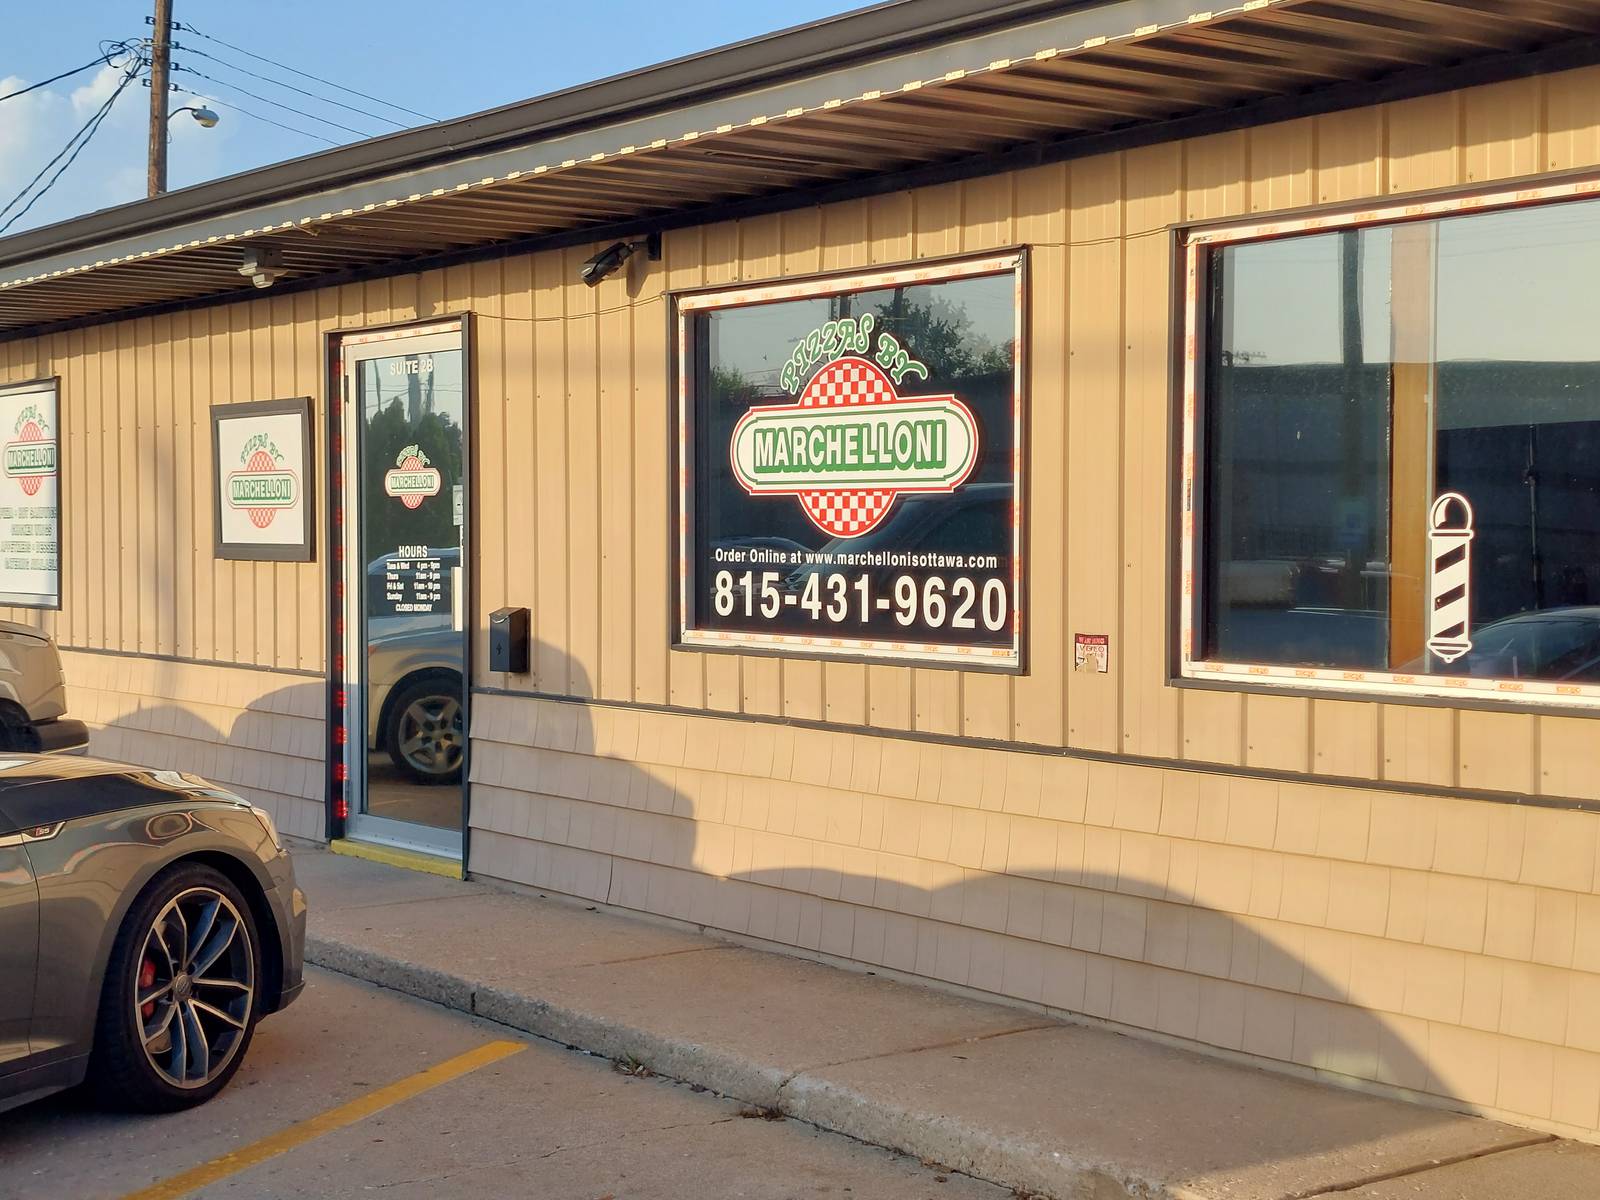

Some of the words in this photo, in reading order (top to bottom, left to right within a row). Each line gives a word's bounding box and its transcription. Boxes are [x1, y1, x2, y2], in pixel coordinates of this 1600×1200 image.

[780, 312, 875, 395] PIZZAS
[876, 332, 929, 386] BY
[390, 360, 418, 375] SUITE
[753, 419, 948, 474] MARCHELLONI
[8, 447, 54, 470] MARCHELLONI
[232, 478, 291, 500] MARCHELLONI
[398, 545, 428, 558] HOURS
[715, 548, 747, 564] Order
[749, 548, 787, 566] Online
[790, 551, 802, 566] at
[805, 549, 998, 570] www.marchellonisottawa.com
[714, 570, 1008, 632] 815-431-9620
